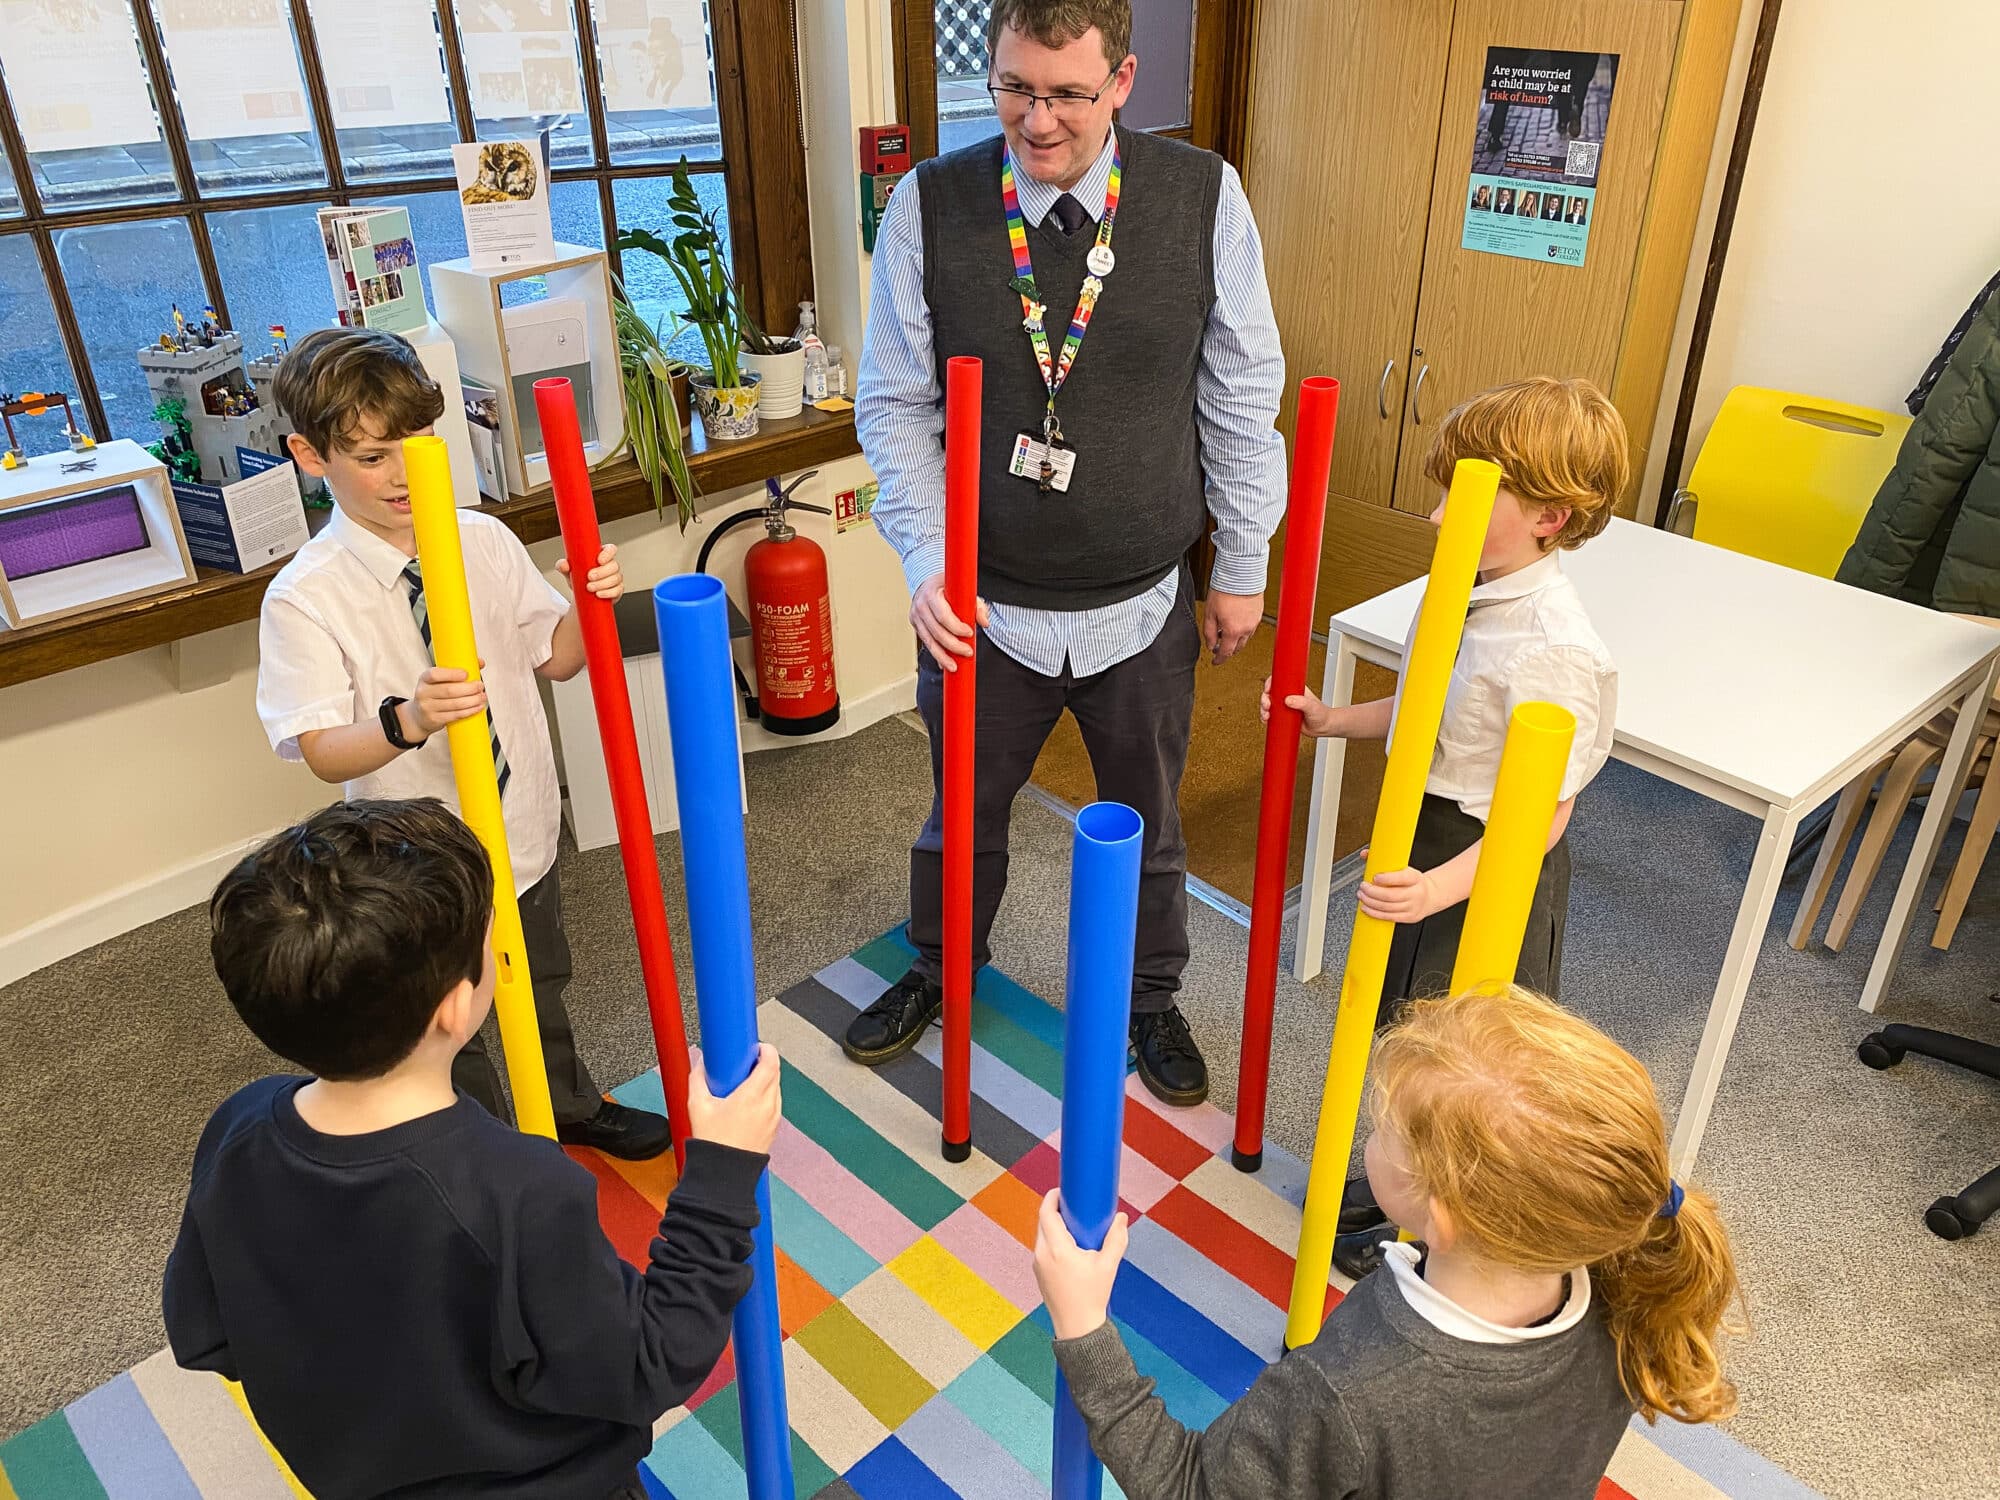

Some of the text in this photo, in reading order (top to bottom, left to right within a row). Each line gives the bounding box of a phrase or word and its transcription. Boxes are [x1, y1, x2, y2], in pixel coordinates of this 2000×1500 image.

[1493, 65, 1571, 80] Are you worried
[1491, 78, 1572, 93] a child may be at
[1489, 91, 1554, 105] risk of harm?
[1515, 181, 1552, 191] SAFEGUARDING
[1557, 246, 1581, 257] ETON
[756, 602, 810, 615] P50-FOAM
